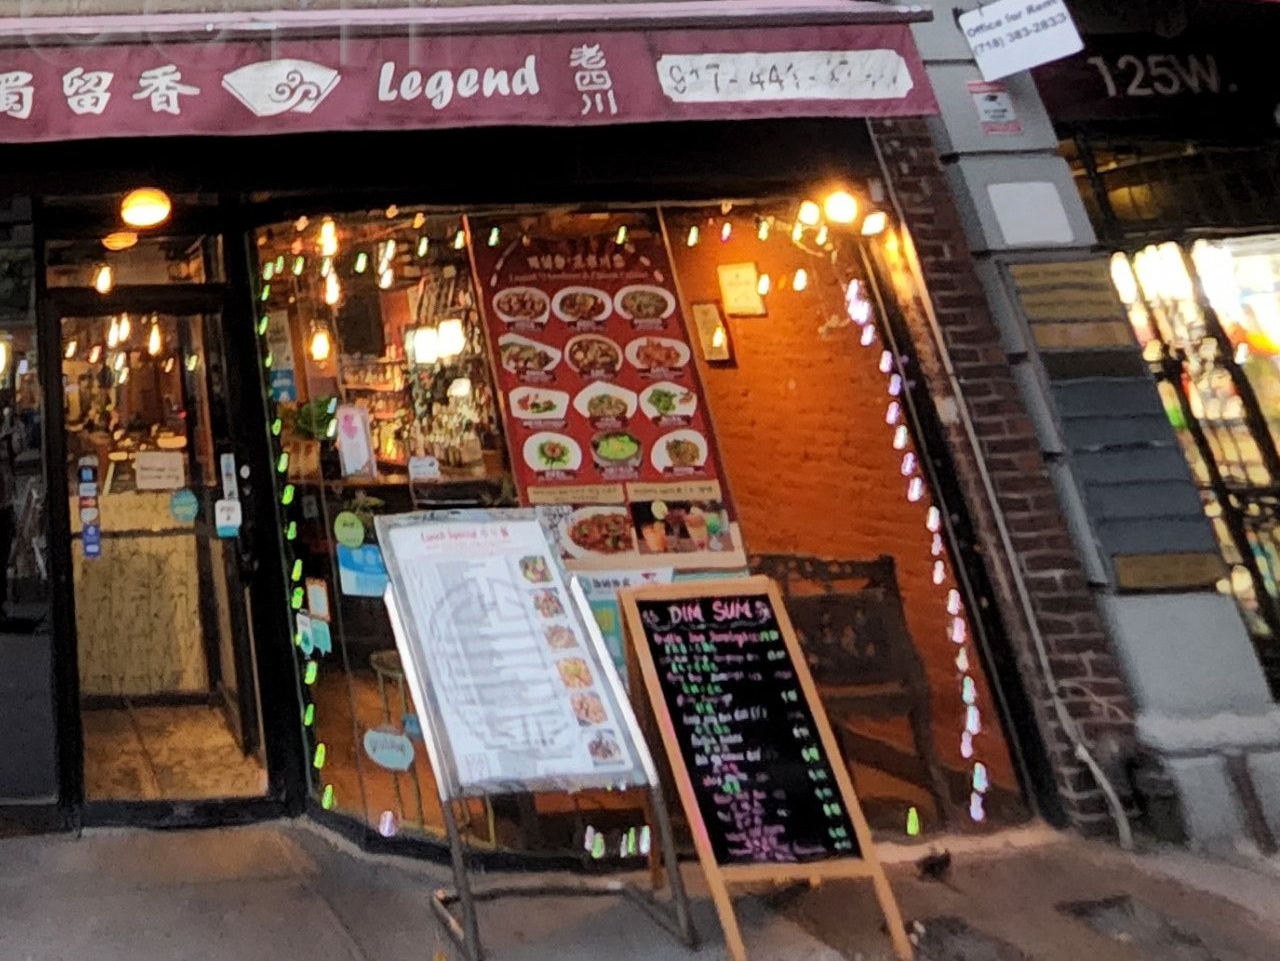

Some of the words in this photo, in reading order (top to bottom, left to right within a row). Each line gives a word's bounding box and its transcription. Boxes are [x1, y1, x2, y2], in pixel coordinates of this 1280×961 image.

[966, 19, 1003, 38] Office
[1005, 10, 1023, 24] for
[378, 54, 540, 111] Legend
[668, 603, 705, 624] DIM
[711, 600, 753, 622] SUM
